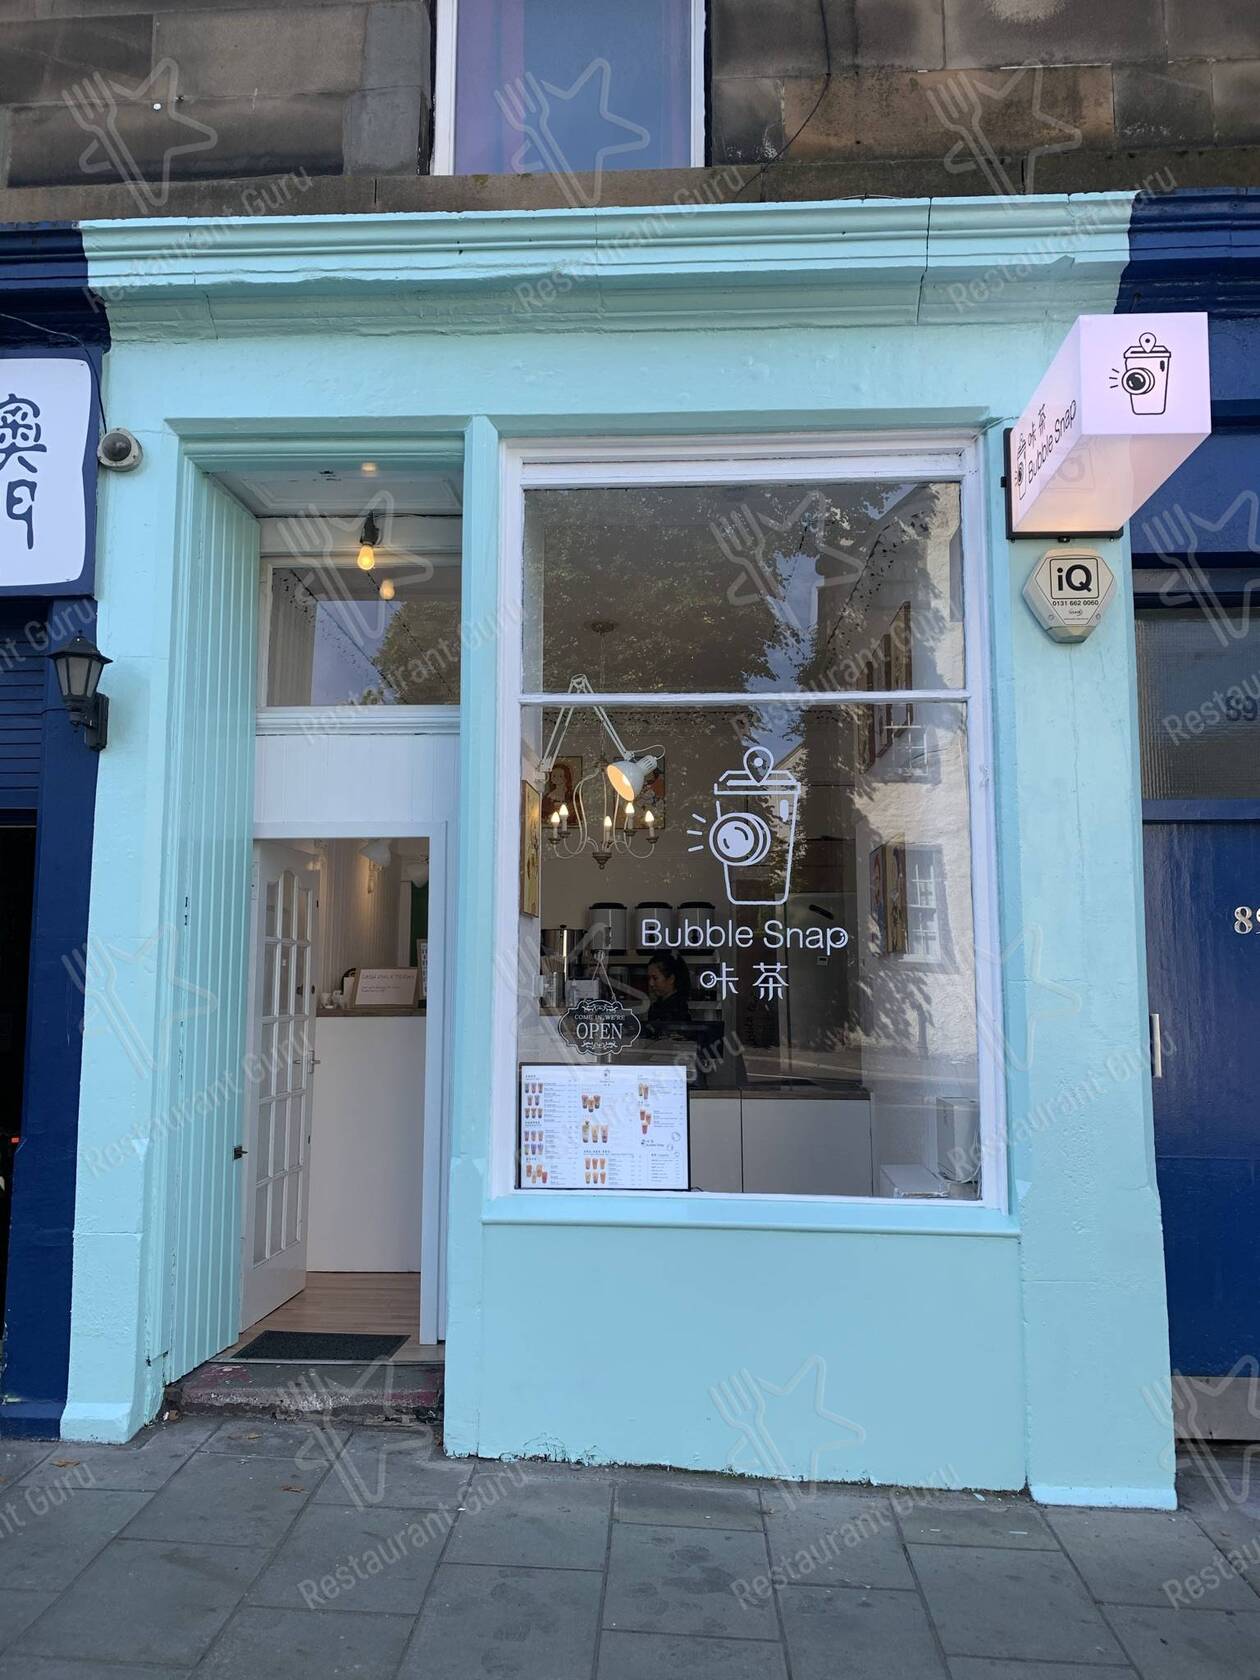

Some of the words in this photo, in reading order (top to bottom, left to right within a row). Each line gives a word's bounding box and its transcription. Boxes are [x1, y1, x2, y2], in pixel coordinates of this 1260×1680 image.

[1027, 434, 1054, 485] Bubble
[1054, 399, 1077, 444] Snap
[1057, 564, 1092, 592] iQ
[1234, 906, 1260, 935] 8
[641, 918, 753, 948] Bubble
[763, 920, 849, 956] Snap
[576, 1022, 623, 1040] OPEN
